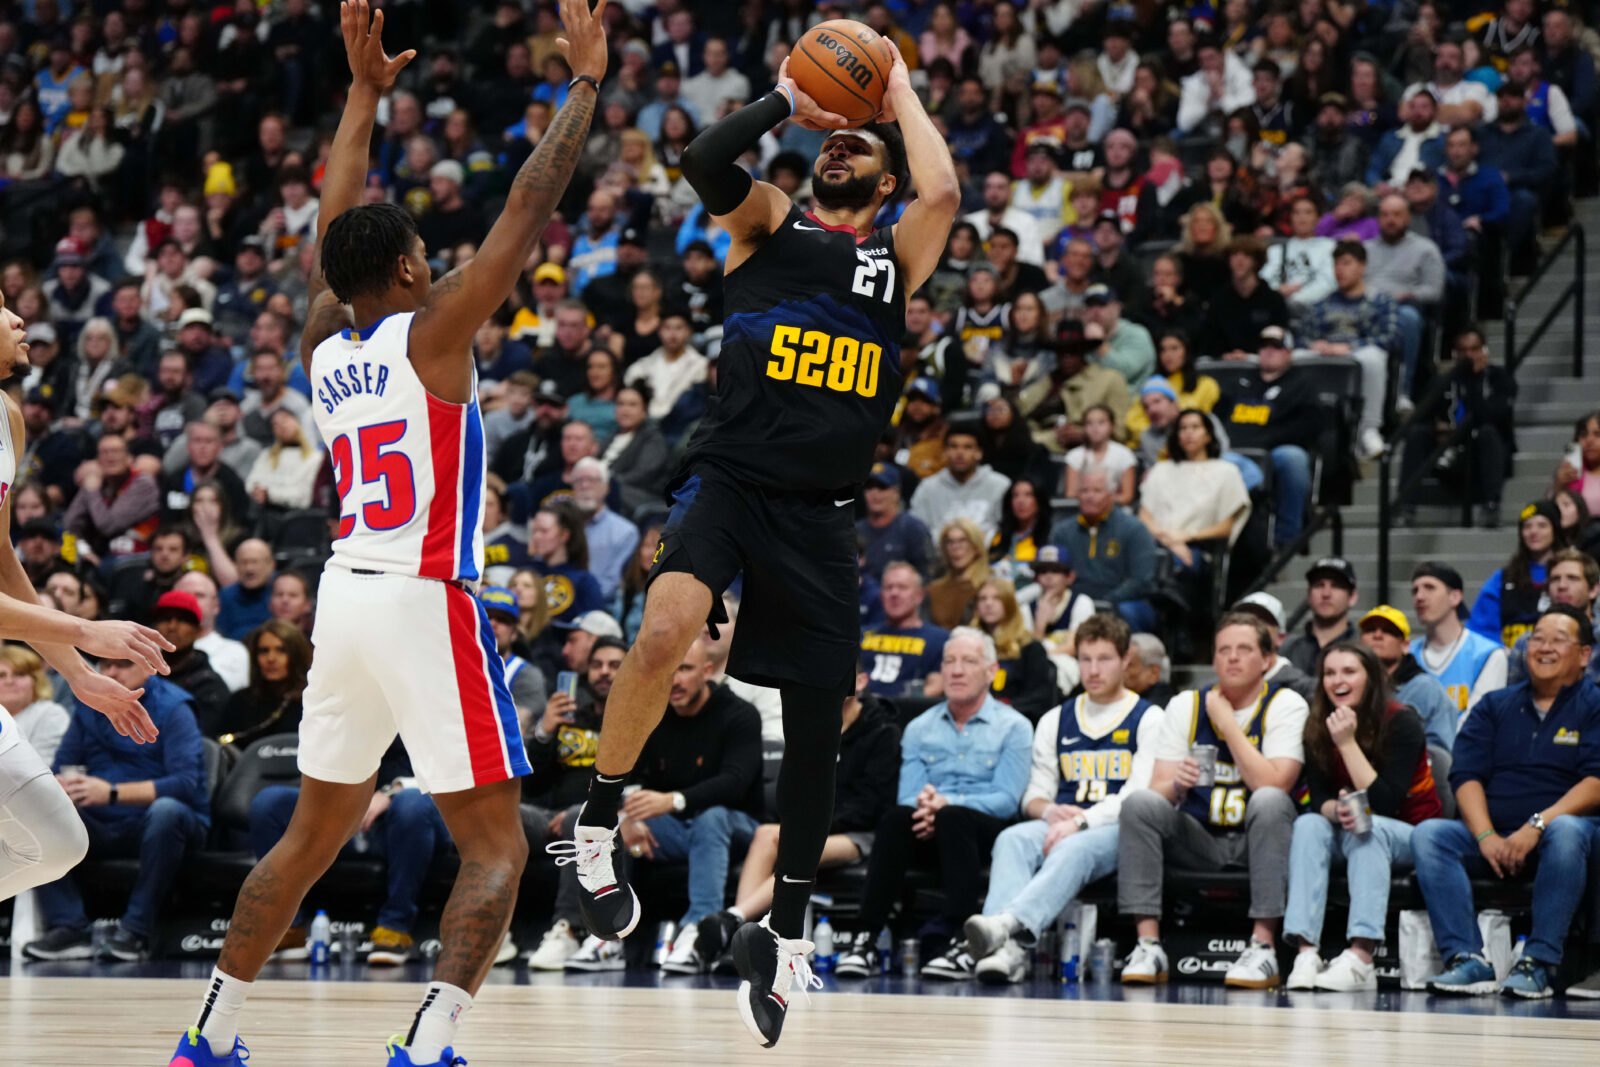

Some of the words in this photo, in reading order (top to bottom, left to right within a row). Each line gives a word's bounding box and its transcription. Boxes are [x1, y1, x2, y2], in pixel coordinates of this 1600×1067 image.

[816, 32, 874, 91] Wilson
[851, 250, 896, 304] 27
[856, 247, 889, 256] otta
[766, 324, 883, 398] 5280
[318, 362, 389, 414] SASSER
[332, 418, 416, 539] 25
[1060, 749, 1132, 782] DENVER
[1209, 786, 1247, 826] 15
[1207, 939, 1248, 952] CLUB
